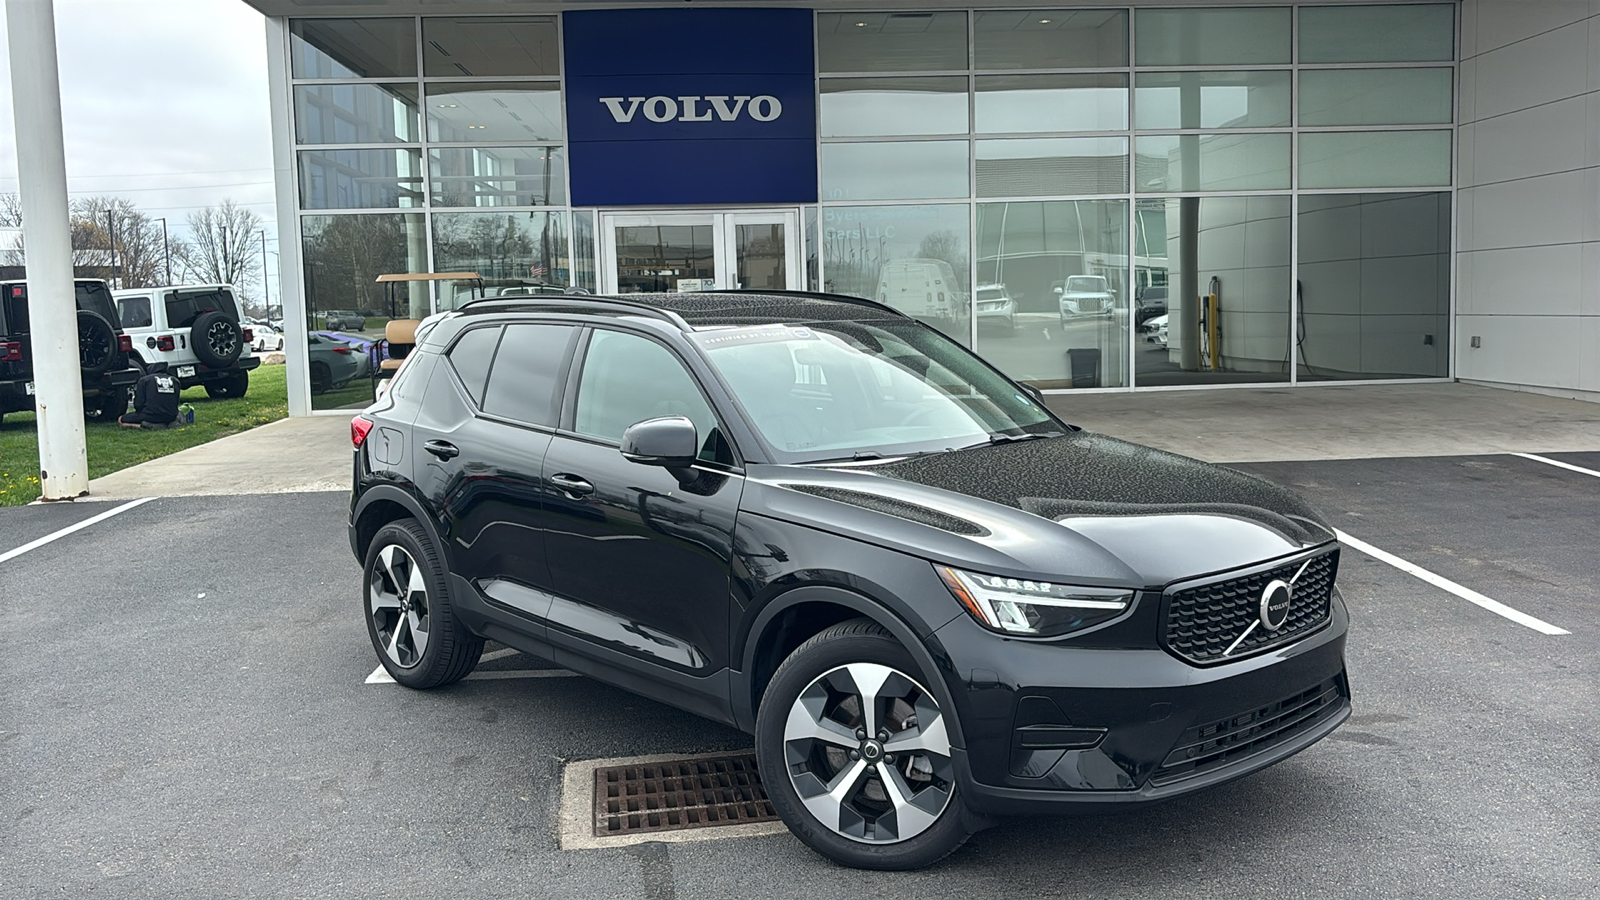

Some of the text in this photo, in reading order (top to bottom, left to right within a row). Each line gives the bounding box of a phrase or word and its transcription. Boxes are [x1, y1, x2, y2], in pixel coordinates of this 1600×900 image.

[599, 95, 782, 123] VOLVO
[825, 225, 896, 240] Cars LLC
[705, 334, 747, 344] CERTIFIED
[1269, 601, 1288, 612] VOLVO
